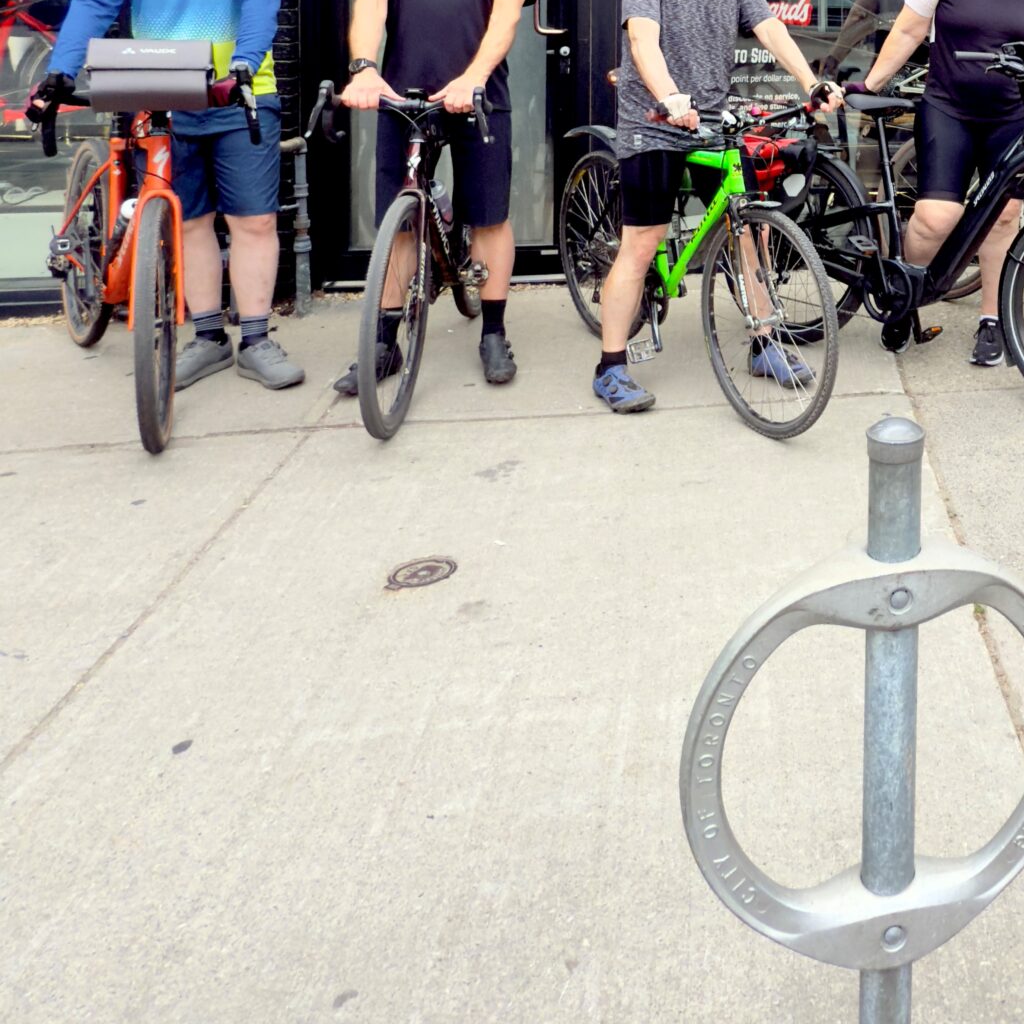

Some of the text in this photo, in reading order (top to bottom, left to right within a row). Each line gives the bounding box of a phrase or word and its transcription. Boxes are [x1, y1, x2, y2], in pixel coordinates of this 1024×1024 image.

[734, 48, 748, 64] TO
[730, 74, 799, 85] point per dollar spe
[697, 655, 757, 904] CITY OF TORONTO
